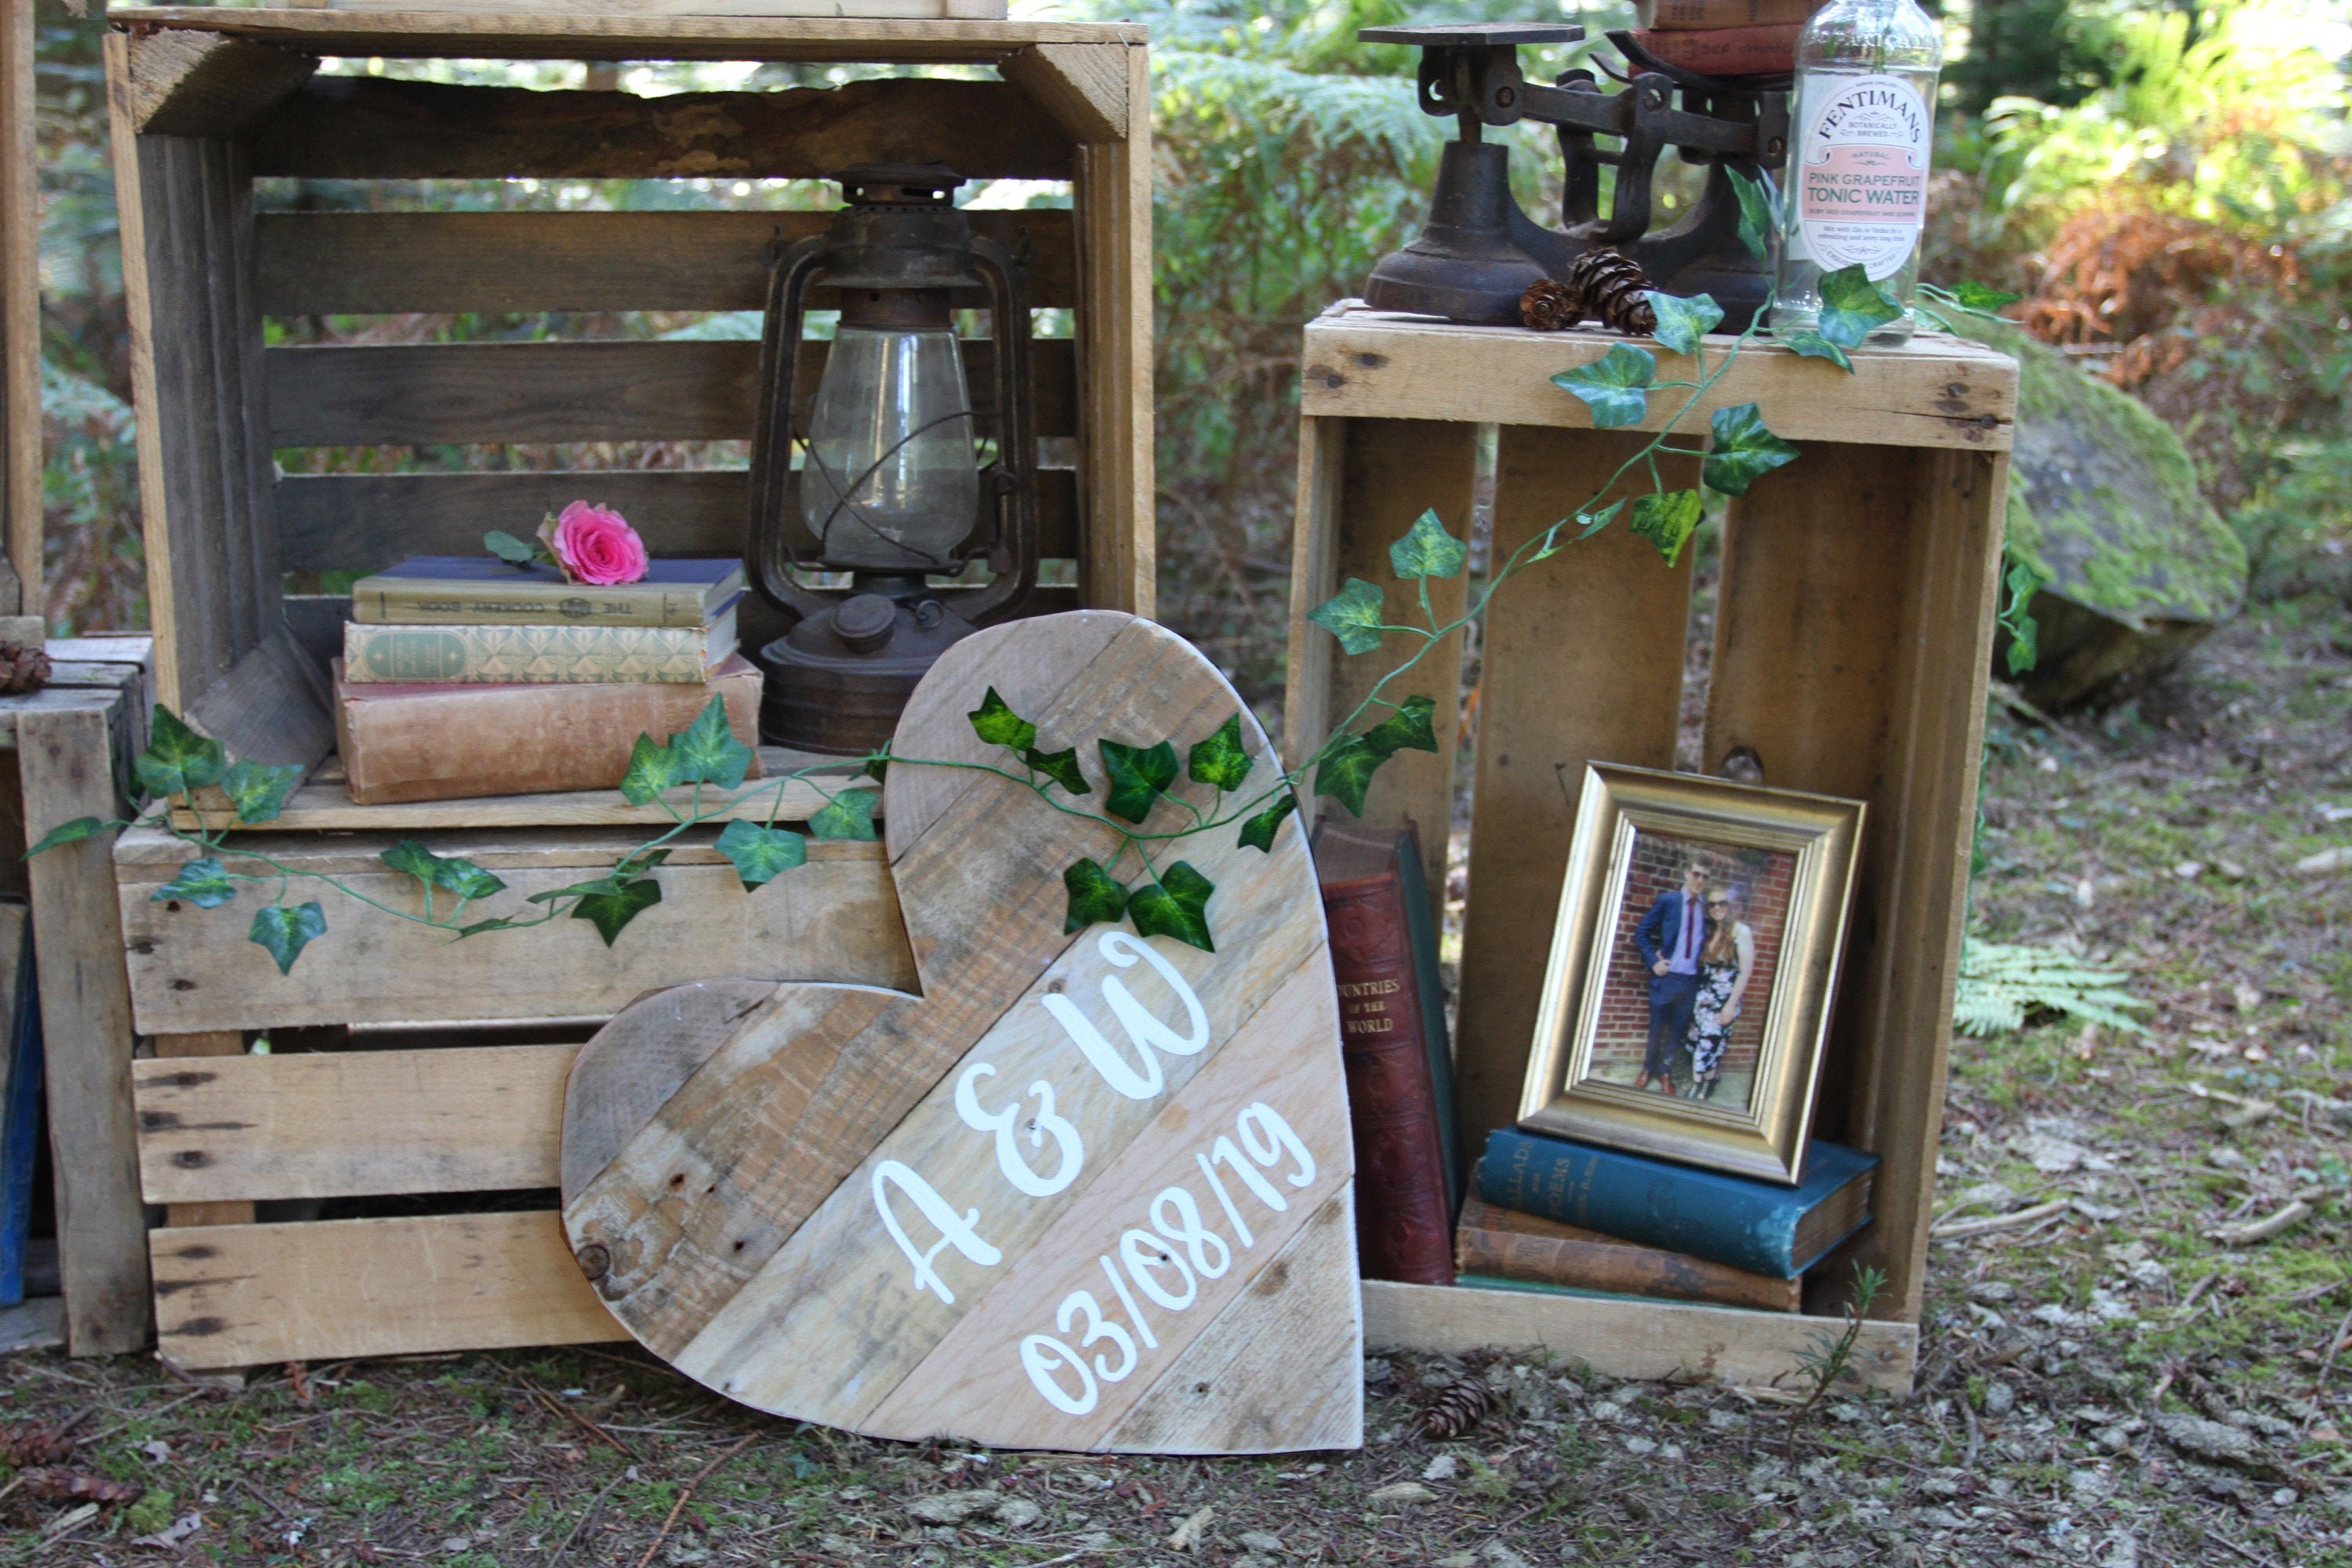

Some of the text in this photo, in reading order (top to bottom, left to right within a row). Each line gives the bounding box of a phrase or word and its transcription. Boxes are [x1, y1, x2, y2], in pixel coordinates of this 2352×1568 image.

[1819, 90, 1920, 143] FENTIMANS
[1807, 187, 1919, 205] TONIC WATER
[1809, 172, 1920, 187] PINK GRAPEFRUIT
[1346, 1018, 1393, 1034] WORLD
[872, 931, 1210, 1304] A & W
[1019, 1102, 1316, 1415] 03/08/19
